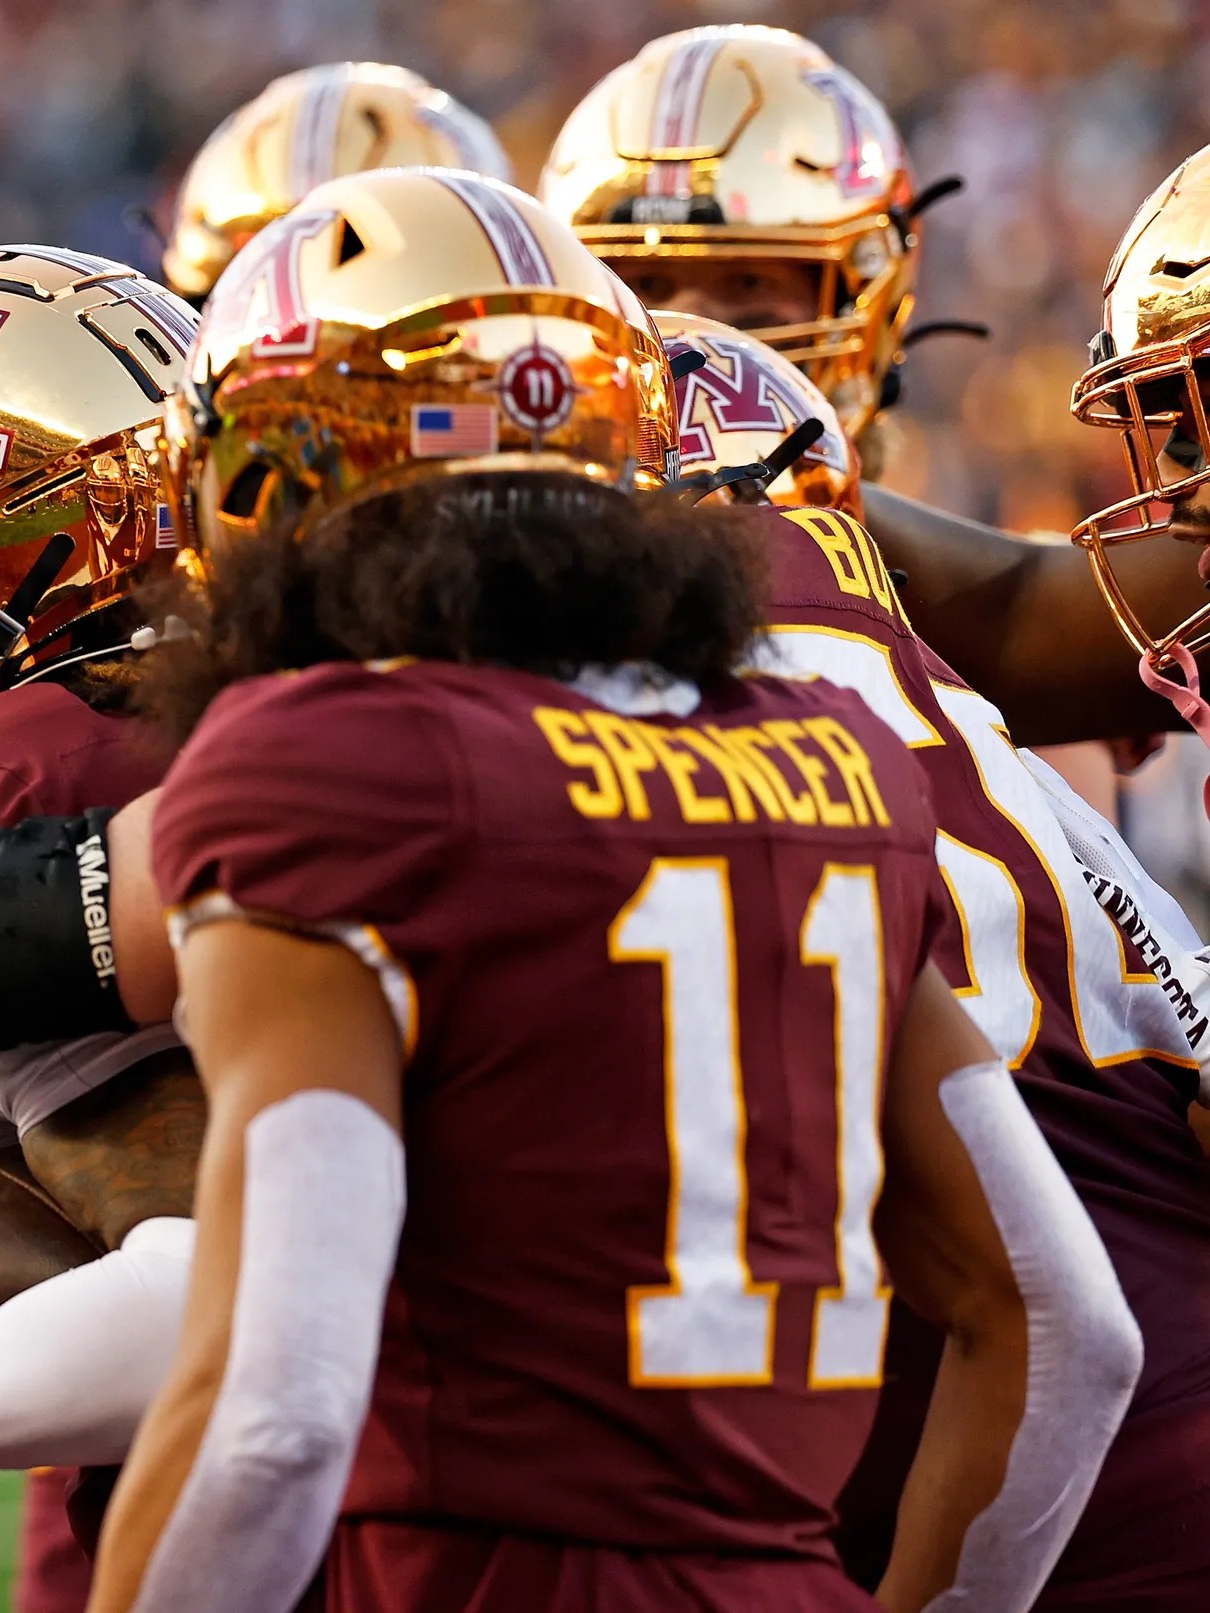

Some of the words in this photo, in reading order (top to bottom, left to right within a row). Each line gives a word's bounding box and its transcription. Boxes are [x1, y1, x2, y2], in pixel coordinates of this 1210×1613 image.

[532, 706, 892, 827] SPENCER
[77, 846, 116, 978] Mueller
[608, 856, 892, 1389] 11
